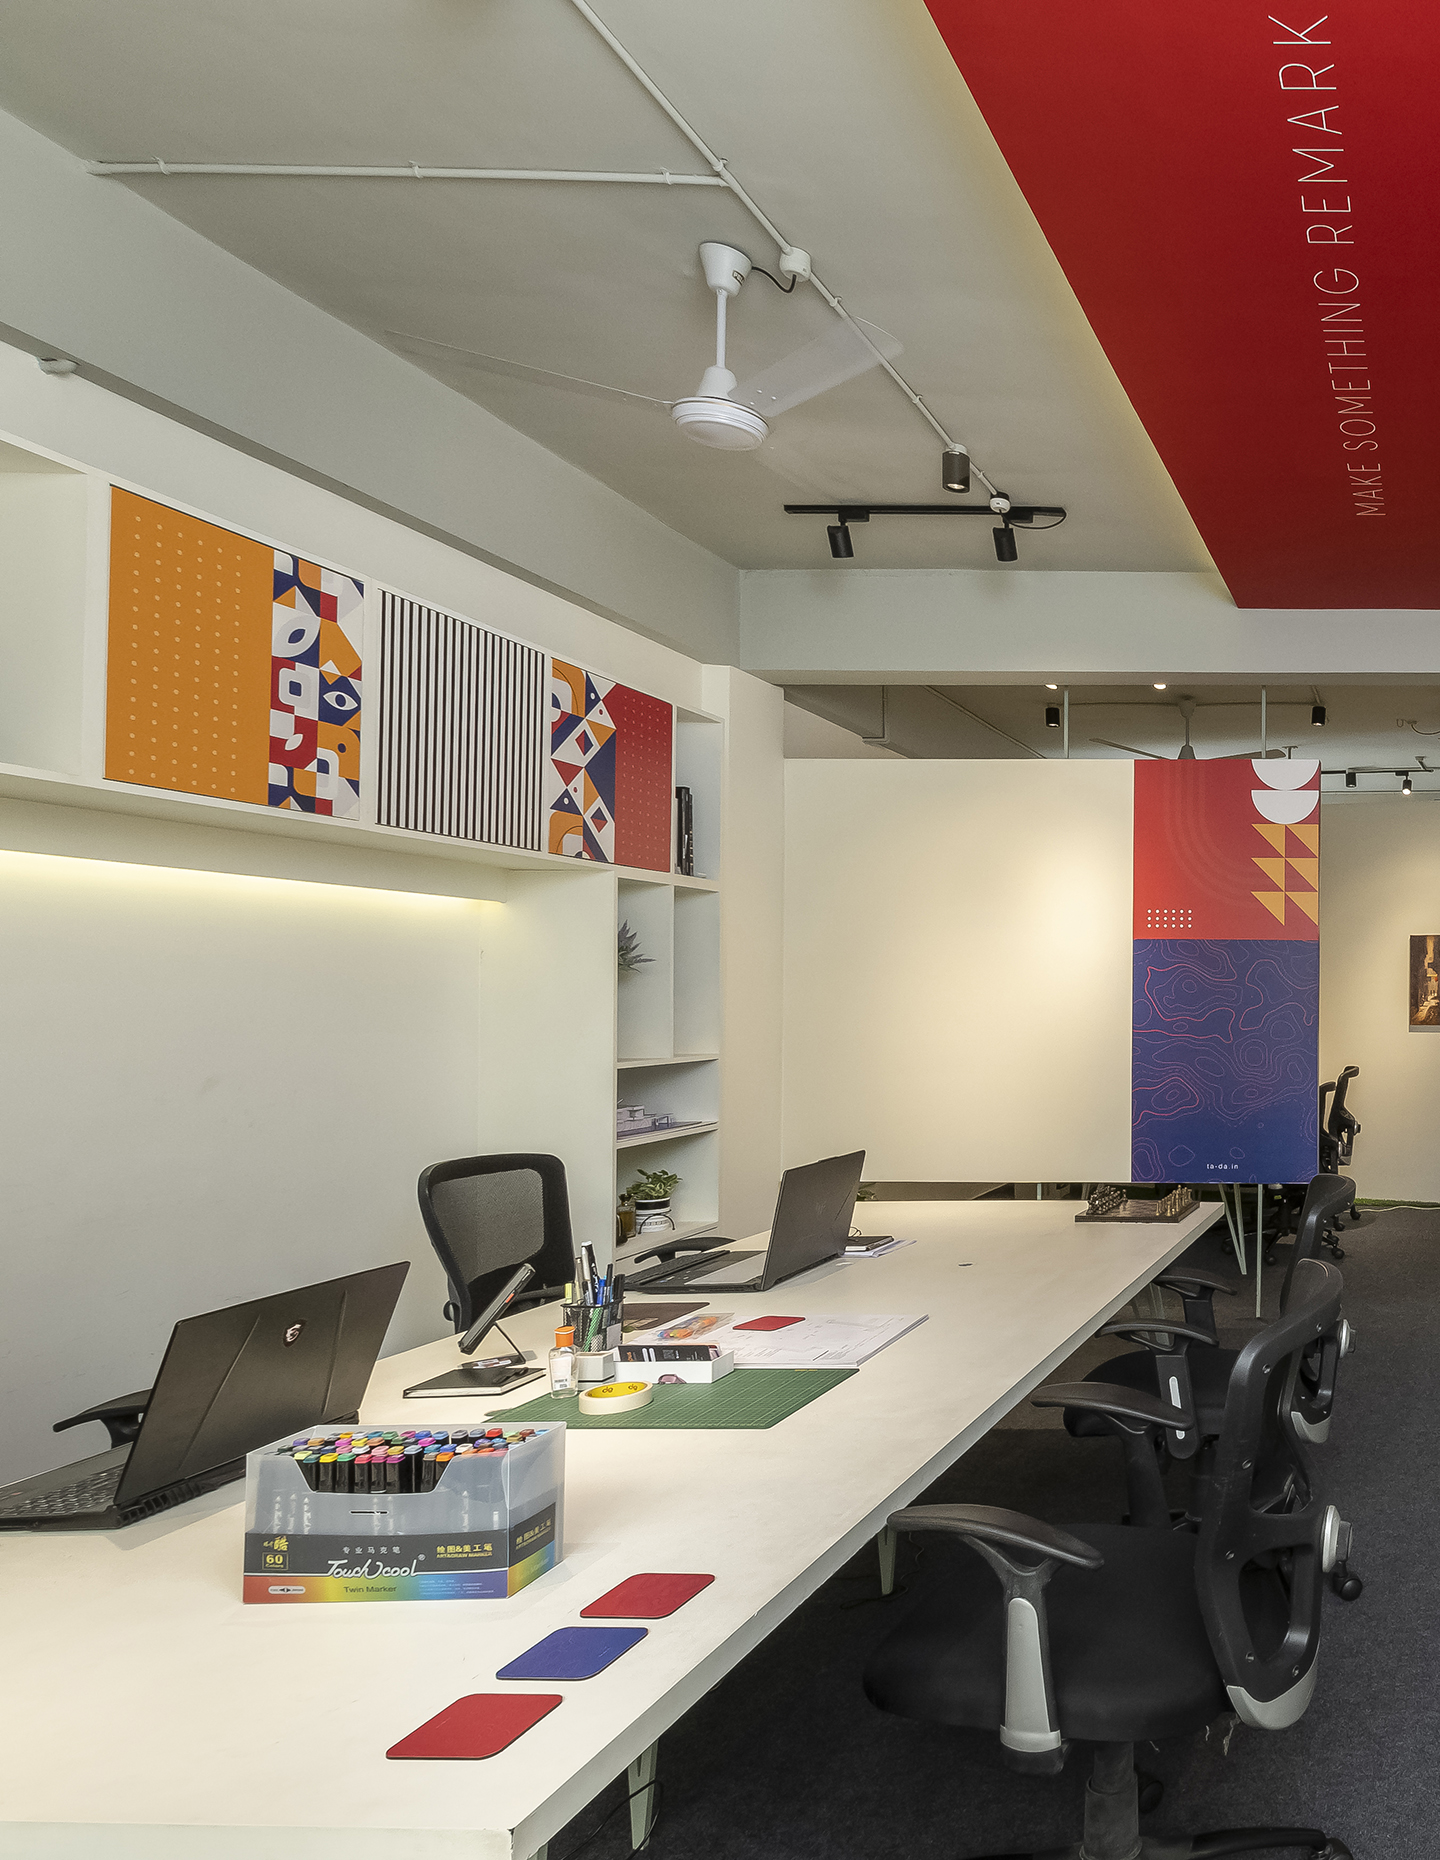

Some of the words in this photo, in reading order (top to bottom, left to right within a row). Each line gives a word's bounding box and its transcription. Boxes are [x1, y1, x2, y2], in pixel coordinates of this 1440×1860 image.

[1267, 14, 1355, 245] REMARK
[1313, 267, 1380, 452] SOMETHING
[1346, 462, 1386, 517] MAKE
[265, 1554, 284, 1564] 60
